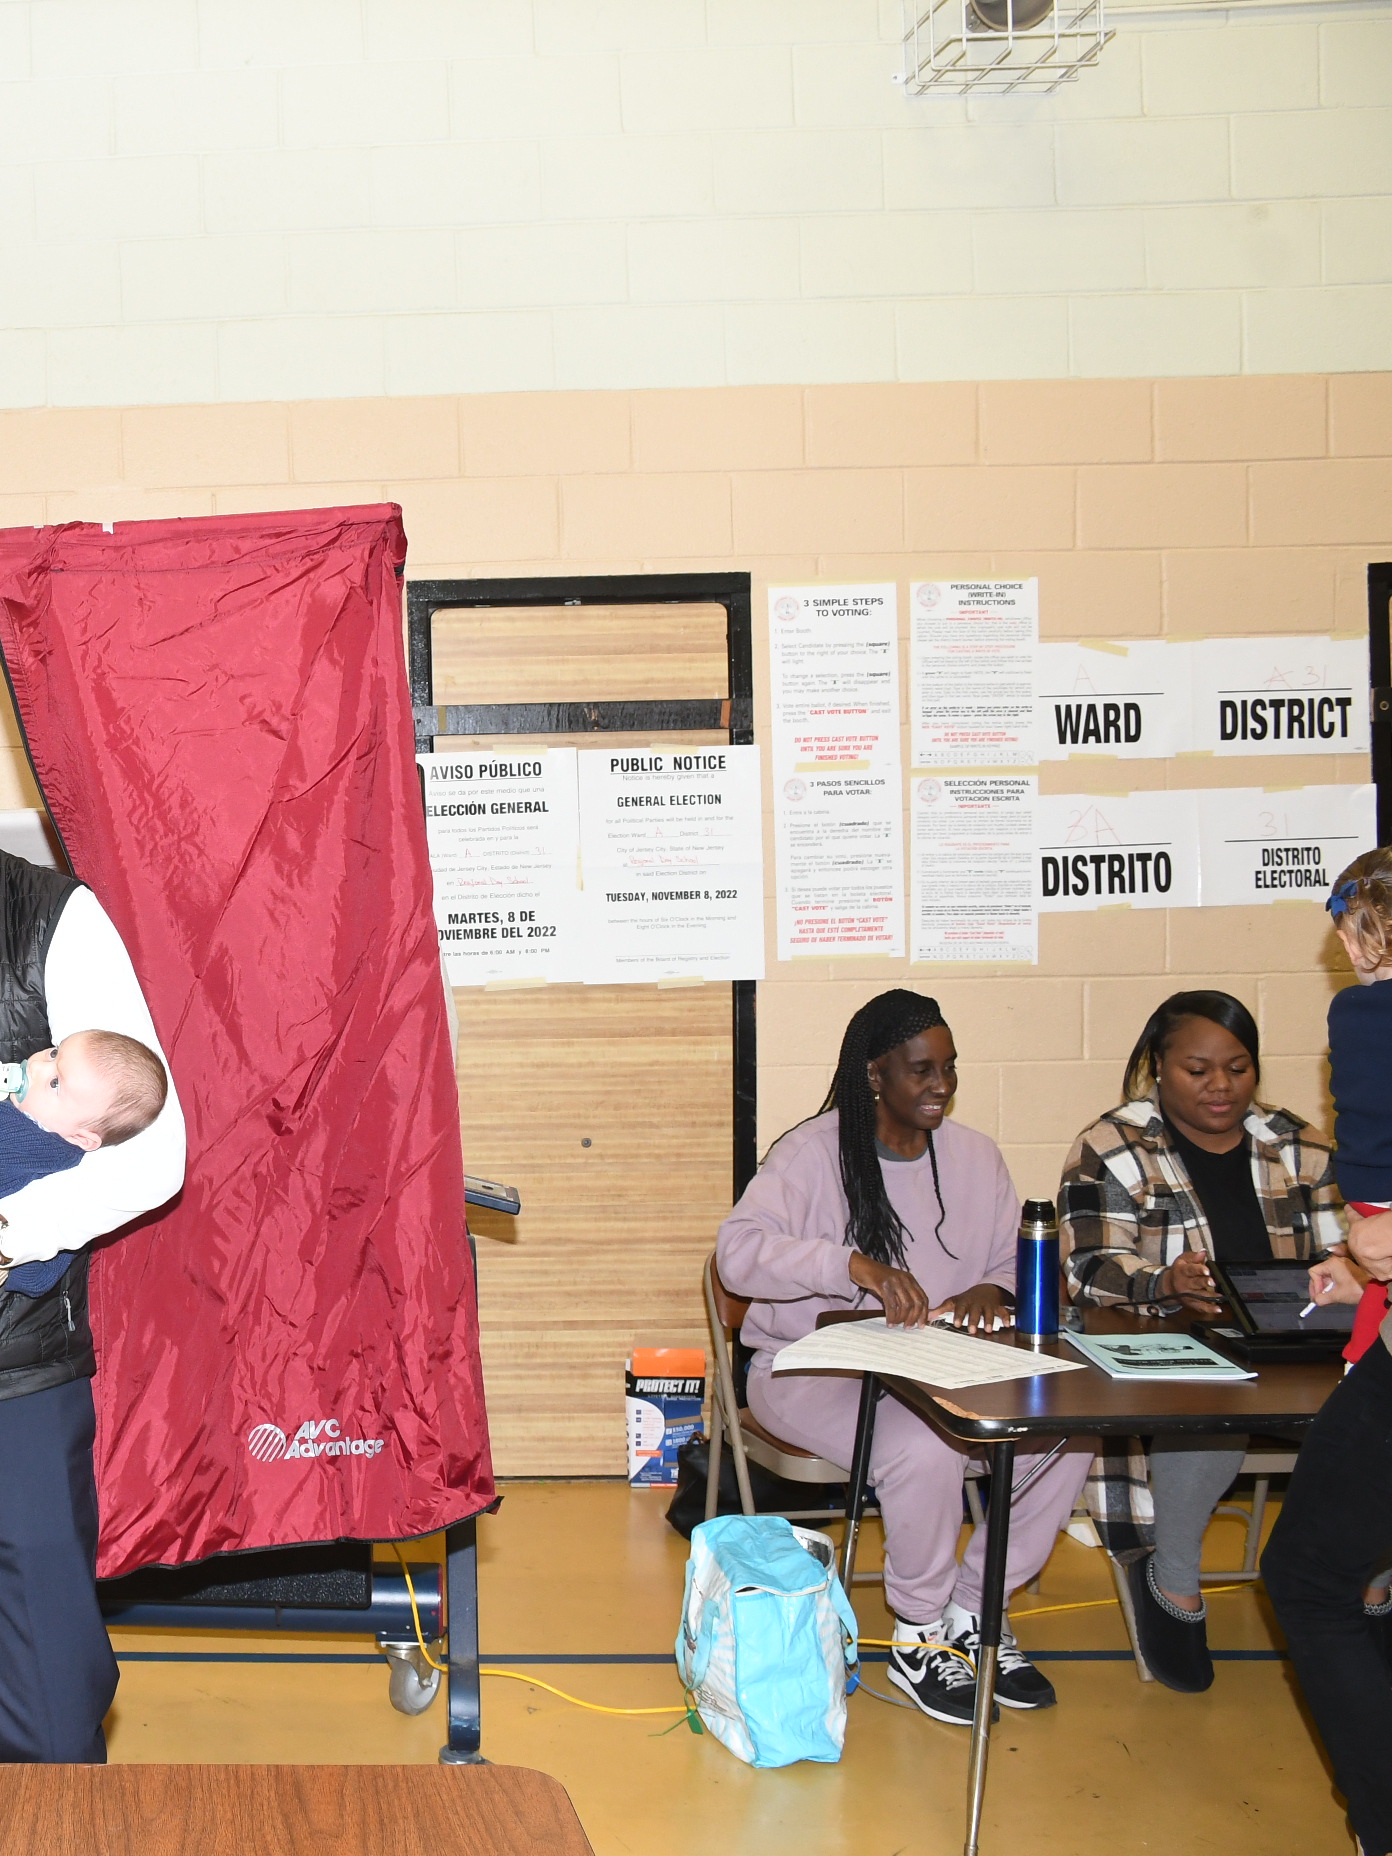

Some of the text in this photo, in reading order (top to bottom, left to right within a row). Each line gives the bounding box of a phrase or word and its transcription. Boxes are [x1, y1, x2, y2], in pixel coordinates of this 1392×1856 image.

[812, 598, 849, 606] SIMPLE
[852, 598, 884, 606] STEPS
[816, 608, 872, 617] TO VOTING:
[1054, 702, 1142, 744] WARD
[1220, 696, 1352, 740] DISTRICT
[430, 760, 542, 780] AVISO PÚBLICO
[610, 754, 726, 772] PUBLIC NOTICE
[427, 801, 549, 817] ELECCIÓN GENERAL
[617, 794, 722, 808] GENERAL ELECTION
[1262, 846, 1321, 867] DISTRITO
[1041, 851, 1172, 897] DISTRITO
[1254, 868, 1330, 889] ELECTORAL
[606, 890, 738, 903] TUESDAY, NOVEMBER 8, 2022
[448, 910, 536, 926] MARTES, 8 DE
[438, 926, 556, 941] OVIEMBRE DEL 2022
[635, 1379, 700, 1393] PROTECT IT!
[294, 1419, 340, 1439] AVC
[284, 1437, 384, 1459] Advantage
